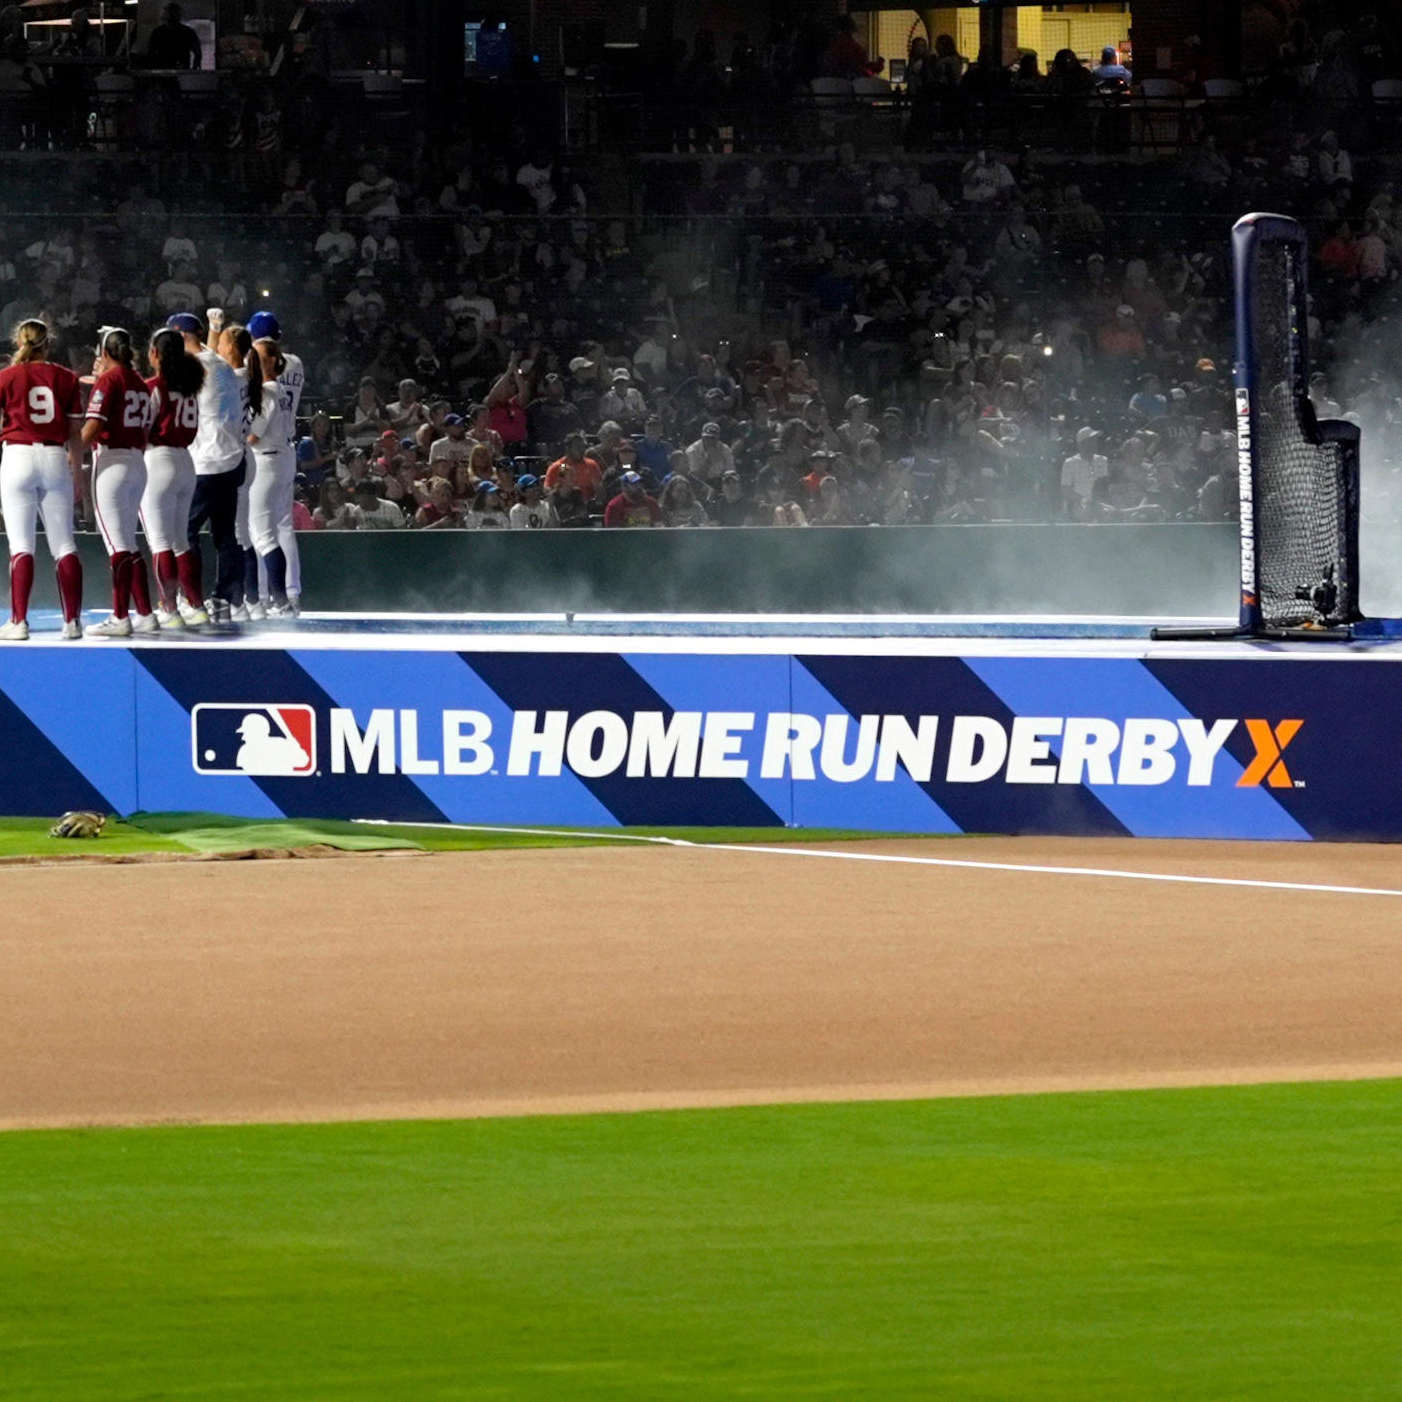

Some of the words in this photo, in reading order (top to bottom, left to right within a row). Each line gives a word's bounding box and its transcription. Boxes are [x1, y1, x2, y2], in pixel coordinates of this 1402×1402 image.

[28, 385, 55, 425] 9
[167, 390, 198, 429] 78
[1237, 416, 1251, 449] MLB
[1238, 451, 1253, 501] HOME
[1240, 501, 1254, 537] RUN
[1241, 537, 1256, 594] DERBY
[330, 708, 493, 776] MLB
[506, 710, 754, 779] HOME
[760, 712, 940, 783] RUN
[946, 715, 1239, 787] DERBY
[1235, 718, 1305, 788] X
